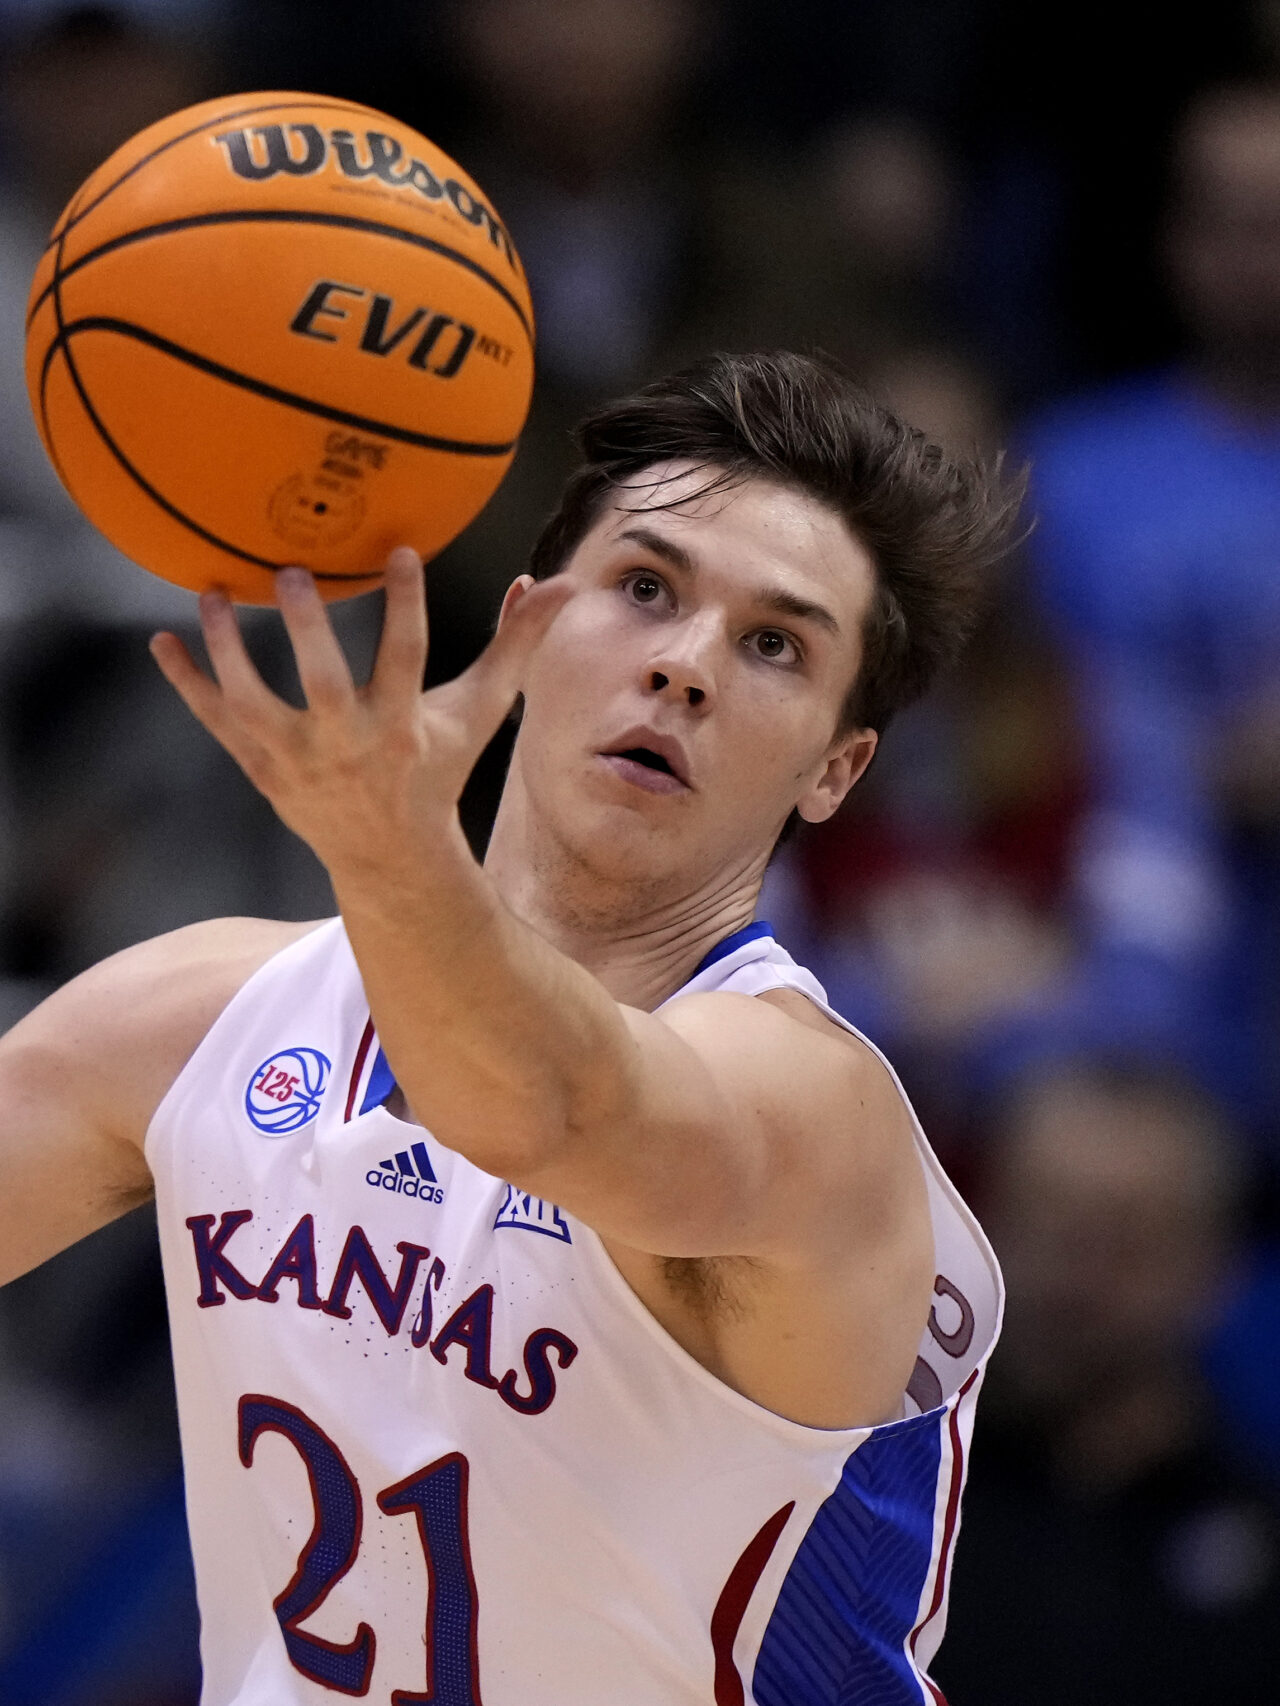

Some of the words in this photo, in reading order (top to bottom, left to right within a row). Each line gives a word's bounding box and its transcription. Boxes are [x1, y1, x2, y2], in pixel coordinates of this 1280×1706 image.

[214, 123, 521, 272] Wilson
[288, 280, 478, 380] EVO
[255, 1064, 301, 1102] 125
[365, 1169, 444, 1205] adidas
[186, 1209, 579, 1416] KANSAS
[238, 1393, 484, 1706] 21
